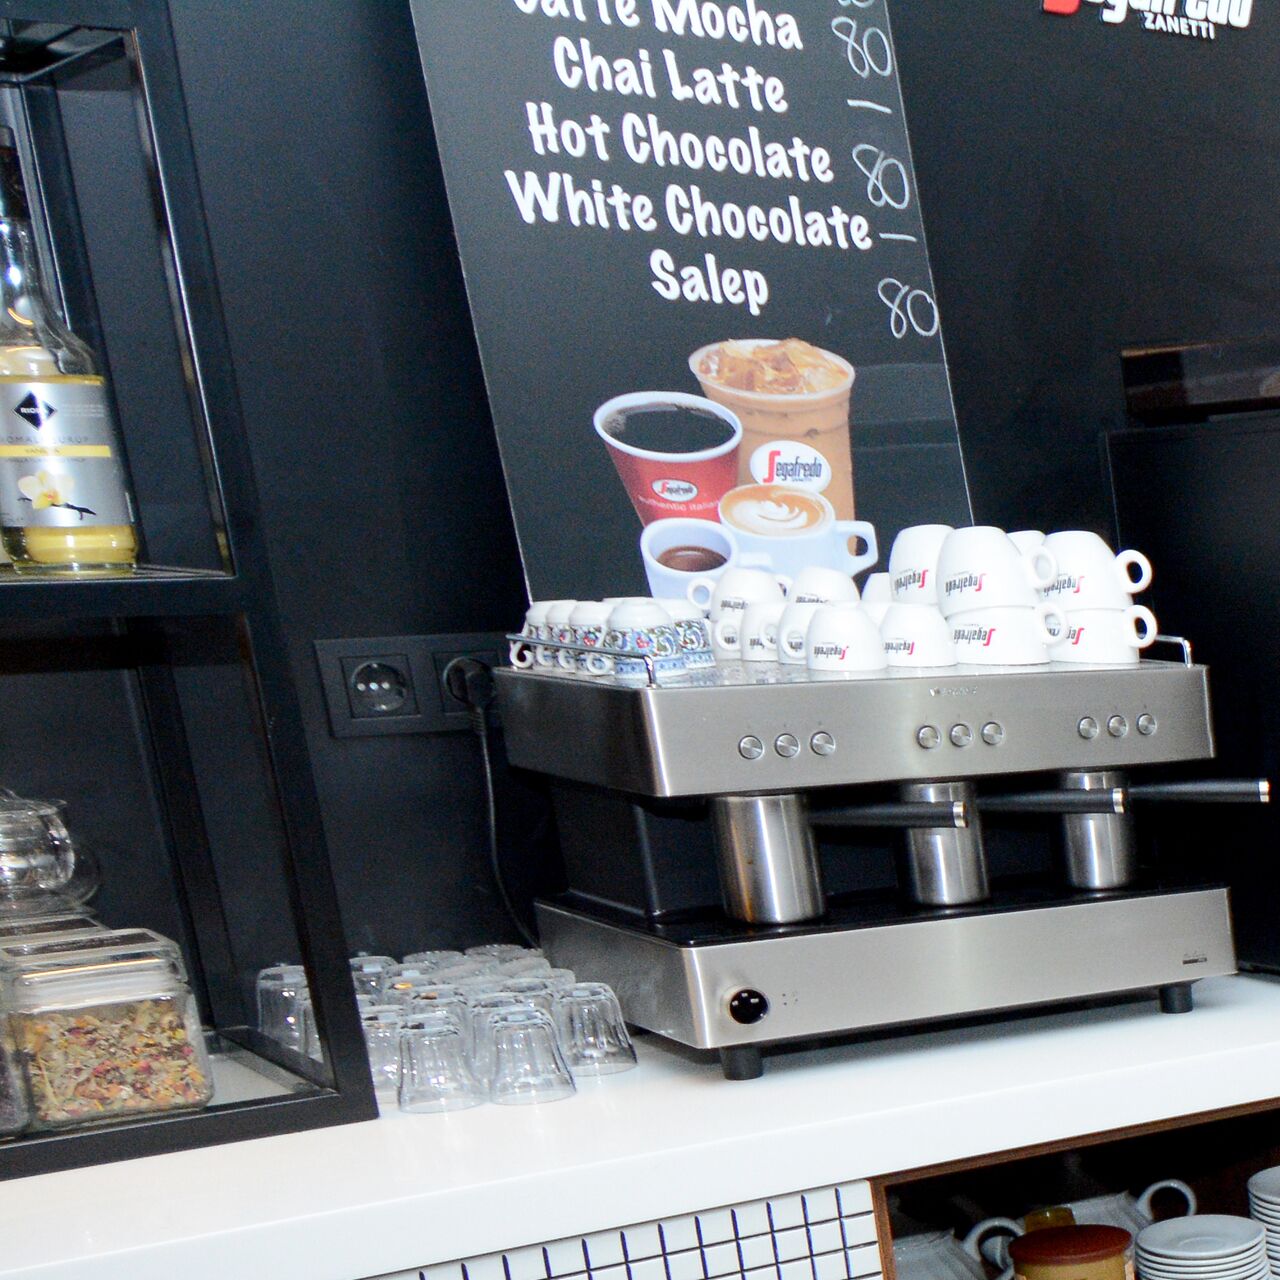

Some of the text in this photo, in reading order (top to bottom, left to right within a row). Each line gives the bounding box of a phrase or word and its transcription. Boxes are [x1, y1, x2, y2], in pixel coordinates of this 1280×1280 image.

[650, 0, 803, 51] Mocha
[831, 16, 892, 78] 80
[1143, 11, 1215, 40] ZANETTI
[553, 36, 789, 113] Chai Latte
[525, 102, 835, 184] Hot Chocolate
[851, 143, 910, 210] 80
[504, 170, 873, 250] White Chocolate
[650, 249, 769, 316] Salep
[877, 277, 940, 339] 80
[762, 449, 823, 484] Segafredo
